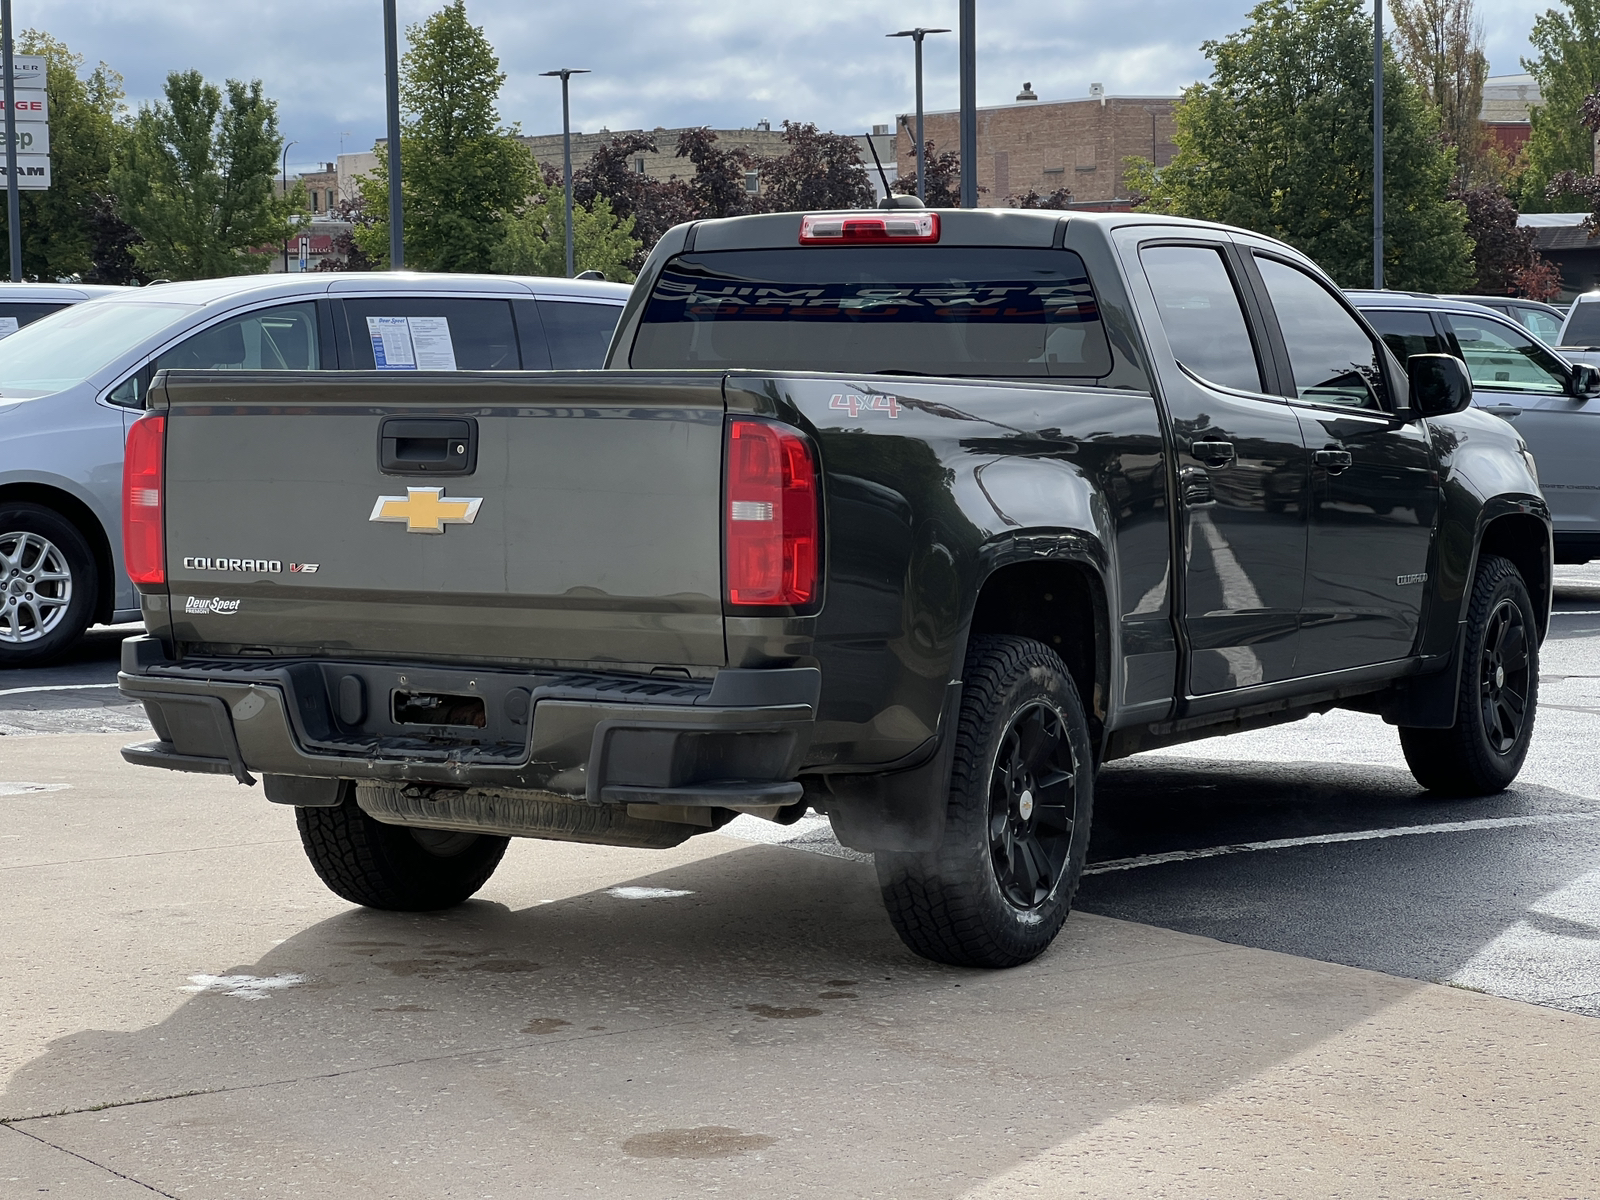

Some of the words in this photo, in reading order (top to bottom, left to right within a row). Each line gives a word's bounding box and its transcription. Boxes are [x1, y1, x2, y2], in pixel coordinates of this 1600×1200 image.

[183, 556, 282, 573] COLORADO
[289, 562, 321, 573] V6
[185, 607, 210, 615] FREMONT
